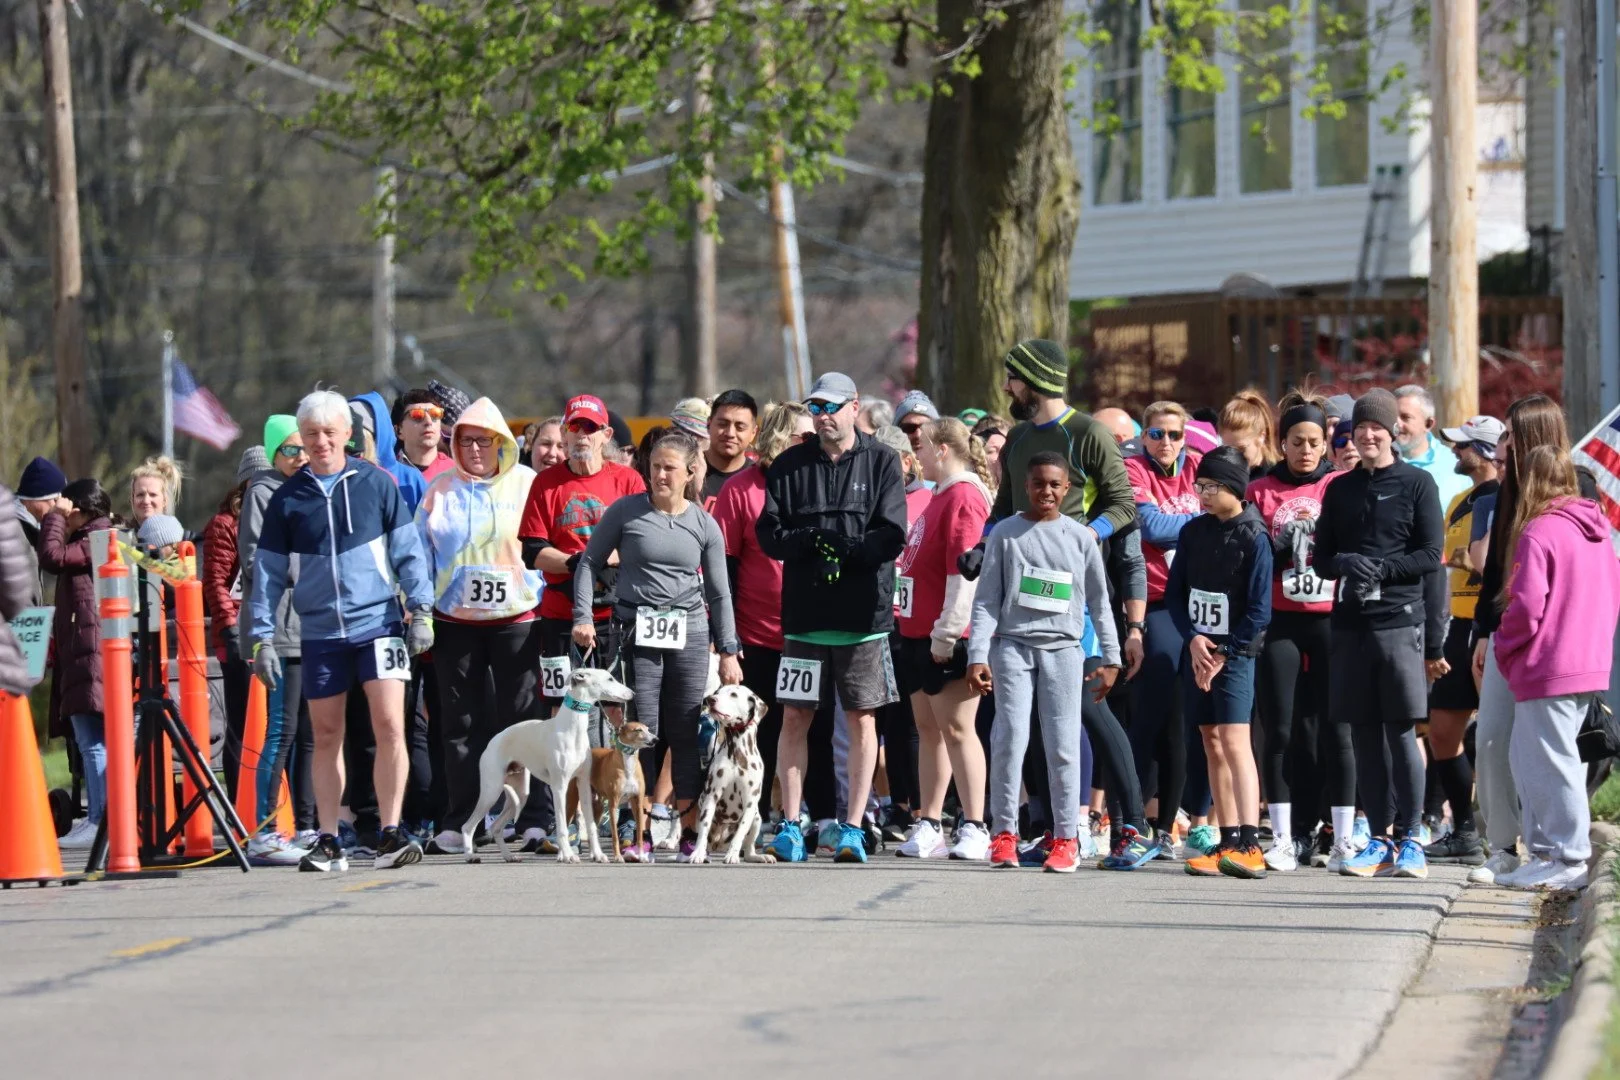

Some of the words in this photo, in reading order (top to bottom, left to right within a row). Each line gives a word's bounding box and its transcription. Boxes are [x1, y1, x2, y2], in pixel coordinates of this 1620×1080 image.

[470, 579, 507, 603] 335
[1040, 580, 1055, 596] 74
[1191, 600, 1222, 627] 315
[643, 616, 679, 641] 394
[779, 667, 813, 693] 370
